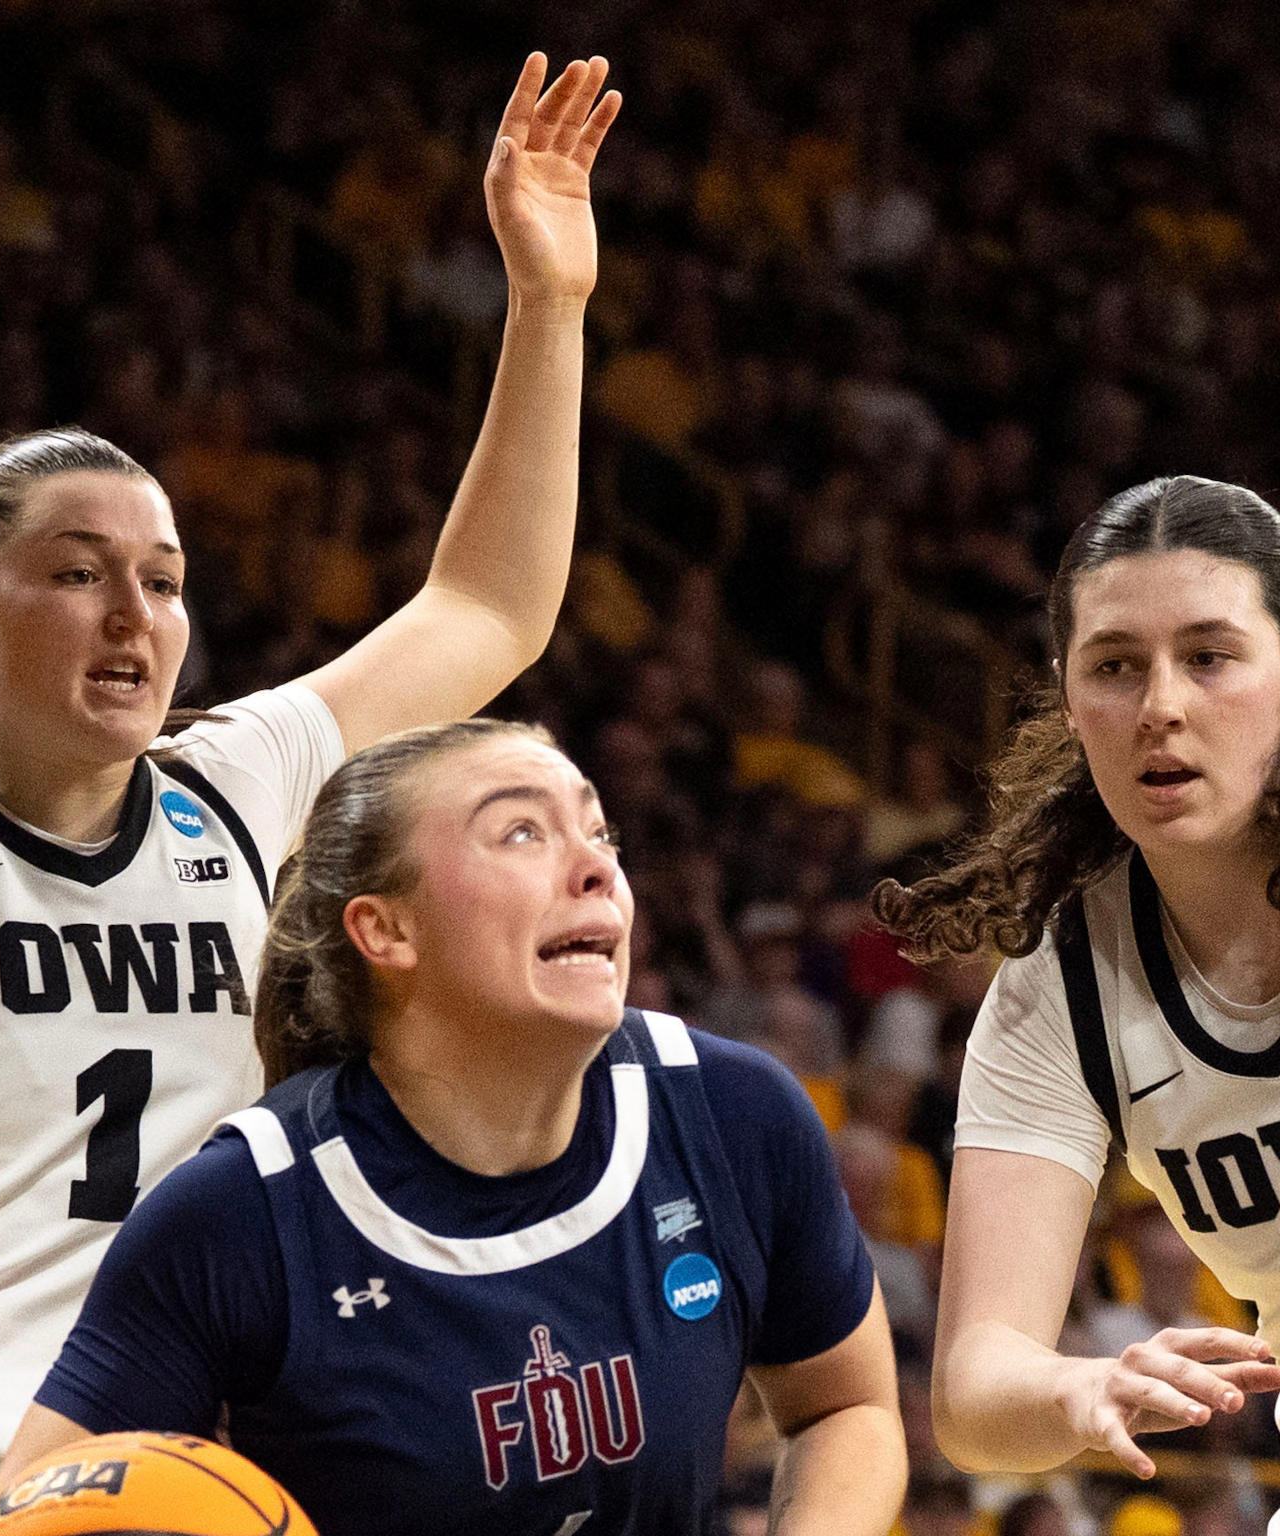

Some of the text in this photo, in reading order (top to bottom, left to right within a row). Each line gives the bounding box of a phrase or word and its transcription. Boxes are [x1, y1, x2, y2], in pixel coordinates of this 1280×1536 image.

[169, 810, 203, 828] NCAA
[69, 1048, 153, 1222] 1
[672, 1279, 720, 1308] NCAA
[472, 1354, 646, 1491] FDU
